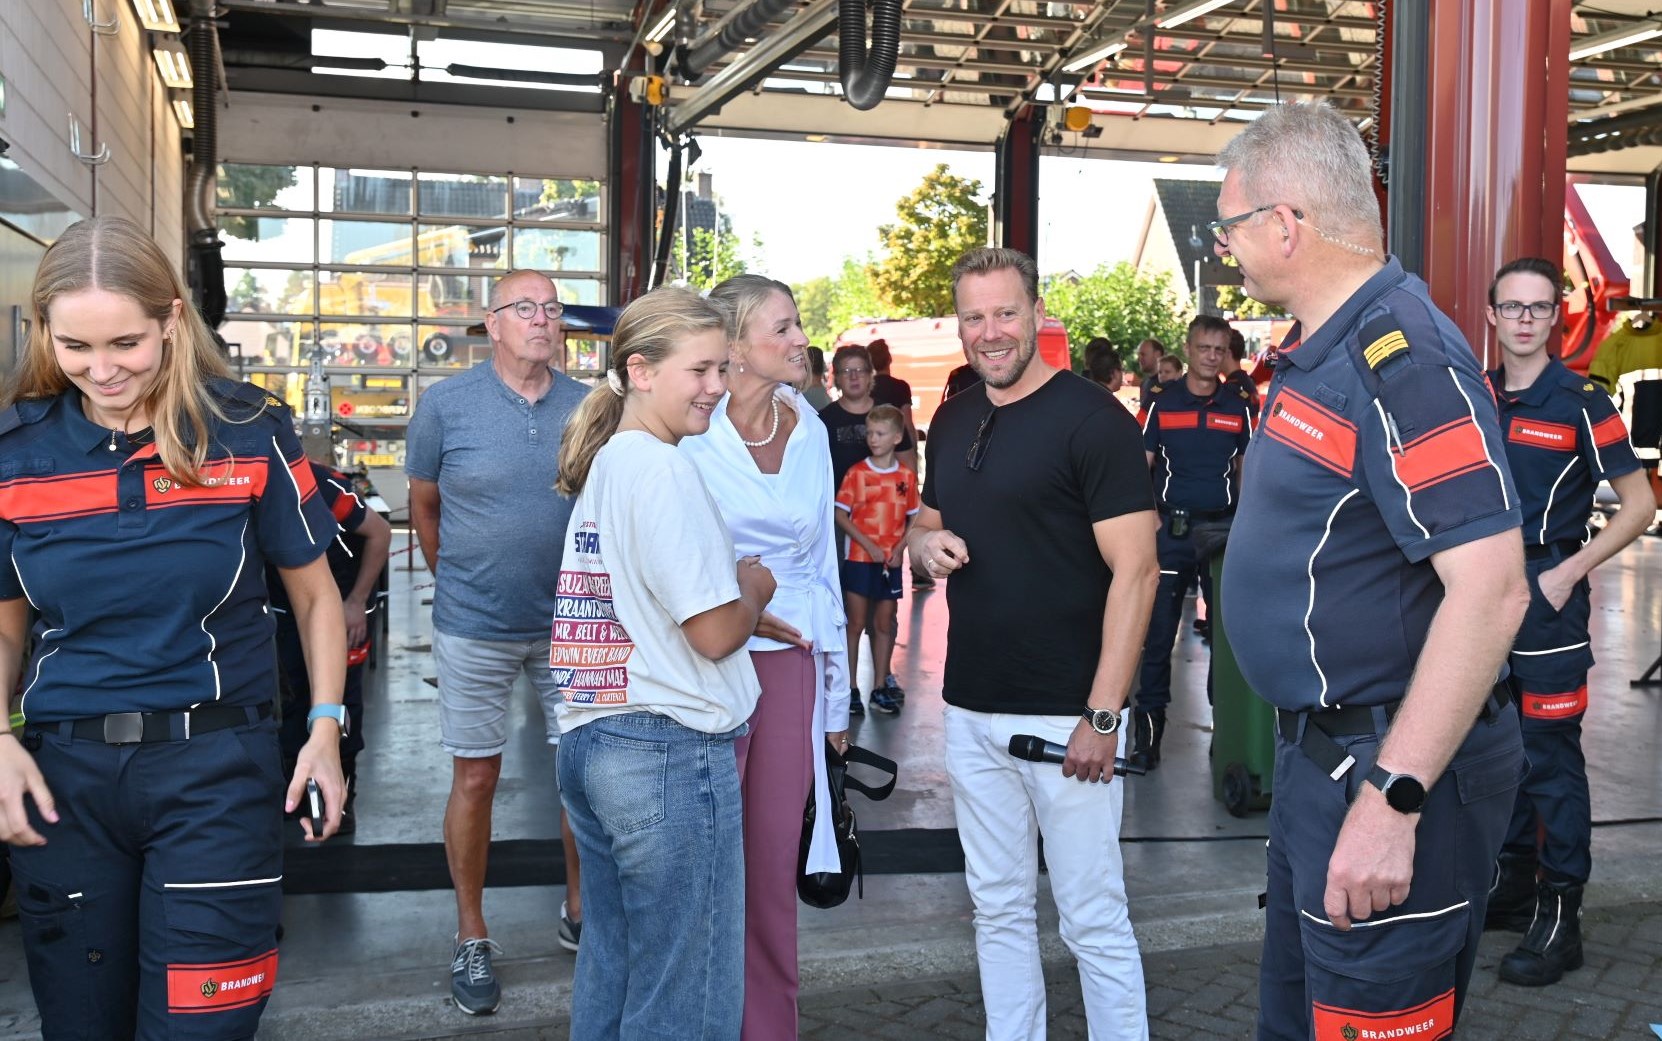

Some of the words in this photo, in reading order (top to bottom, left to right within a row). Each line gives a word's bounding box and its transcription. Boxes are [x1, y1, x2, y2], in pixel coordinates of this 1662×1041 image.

[1278, 409, 1324, 440] BRANDWEER
[1522, 428, 1563, 441] BRANDWEER
[554, 622, 573, 640] MR.
[574, 623, 599, 641] BELT
[600, 623, 608, 643] &
[553, 646, 580, 664] EDWIN
[581, 646, 608, 664] EVERS
[606, 646, 631, 663] BAND
[573, 670, 606, 687] HANNAH
[606, 668, 625, 686] MAE
[1361, 1018, 1435, 1040] BRANDWEER
